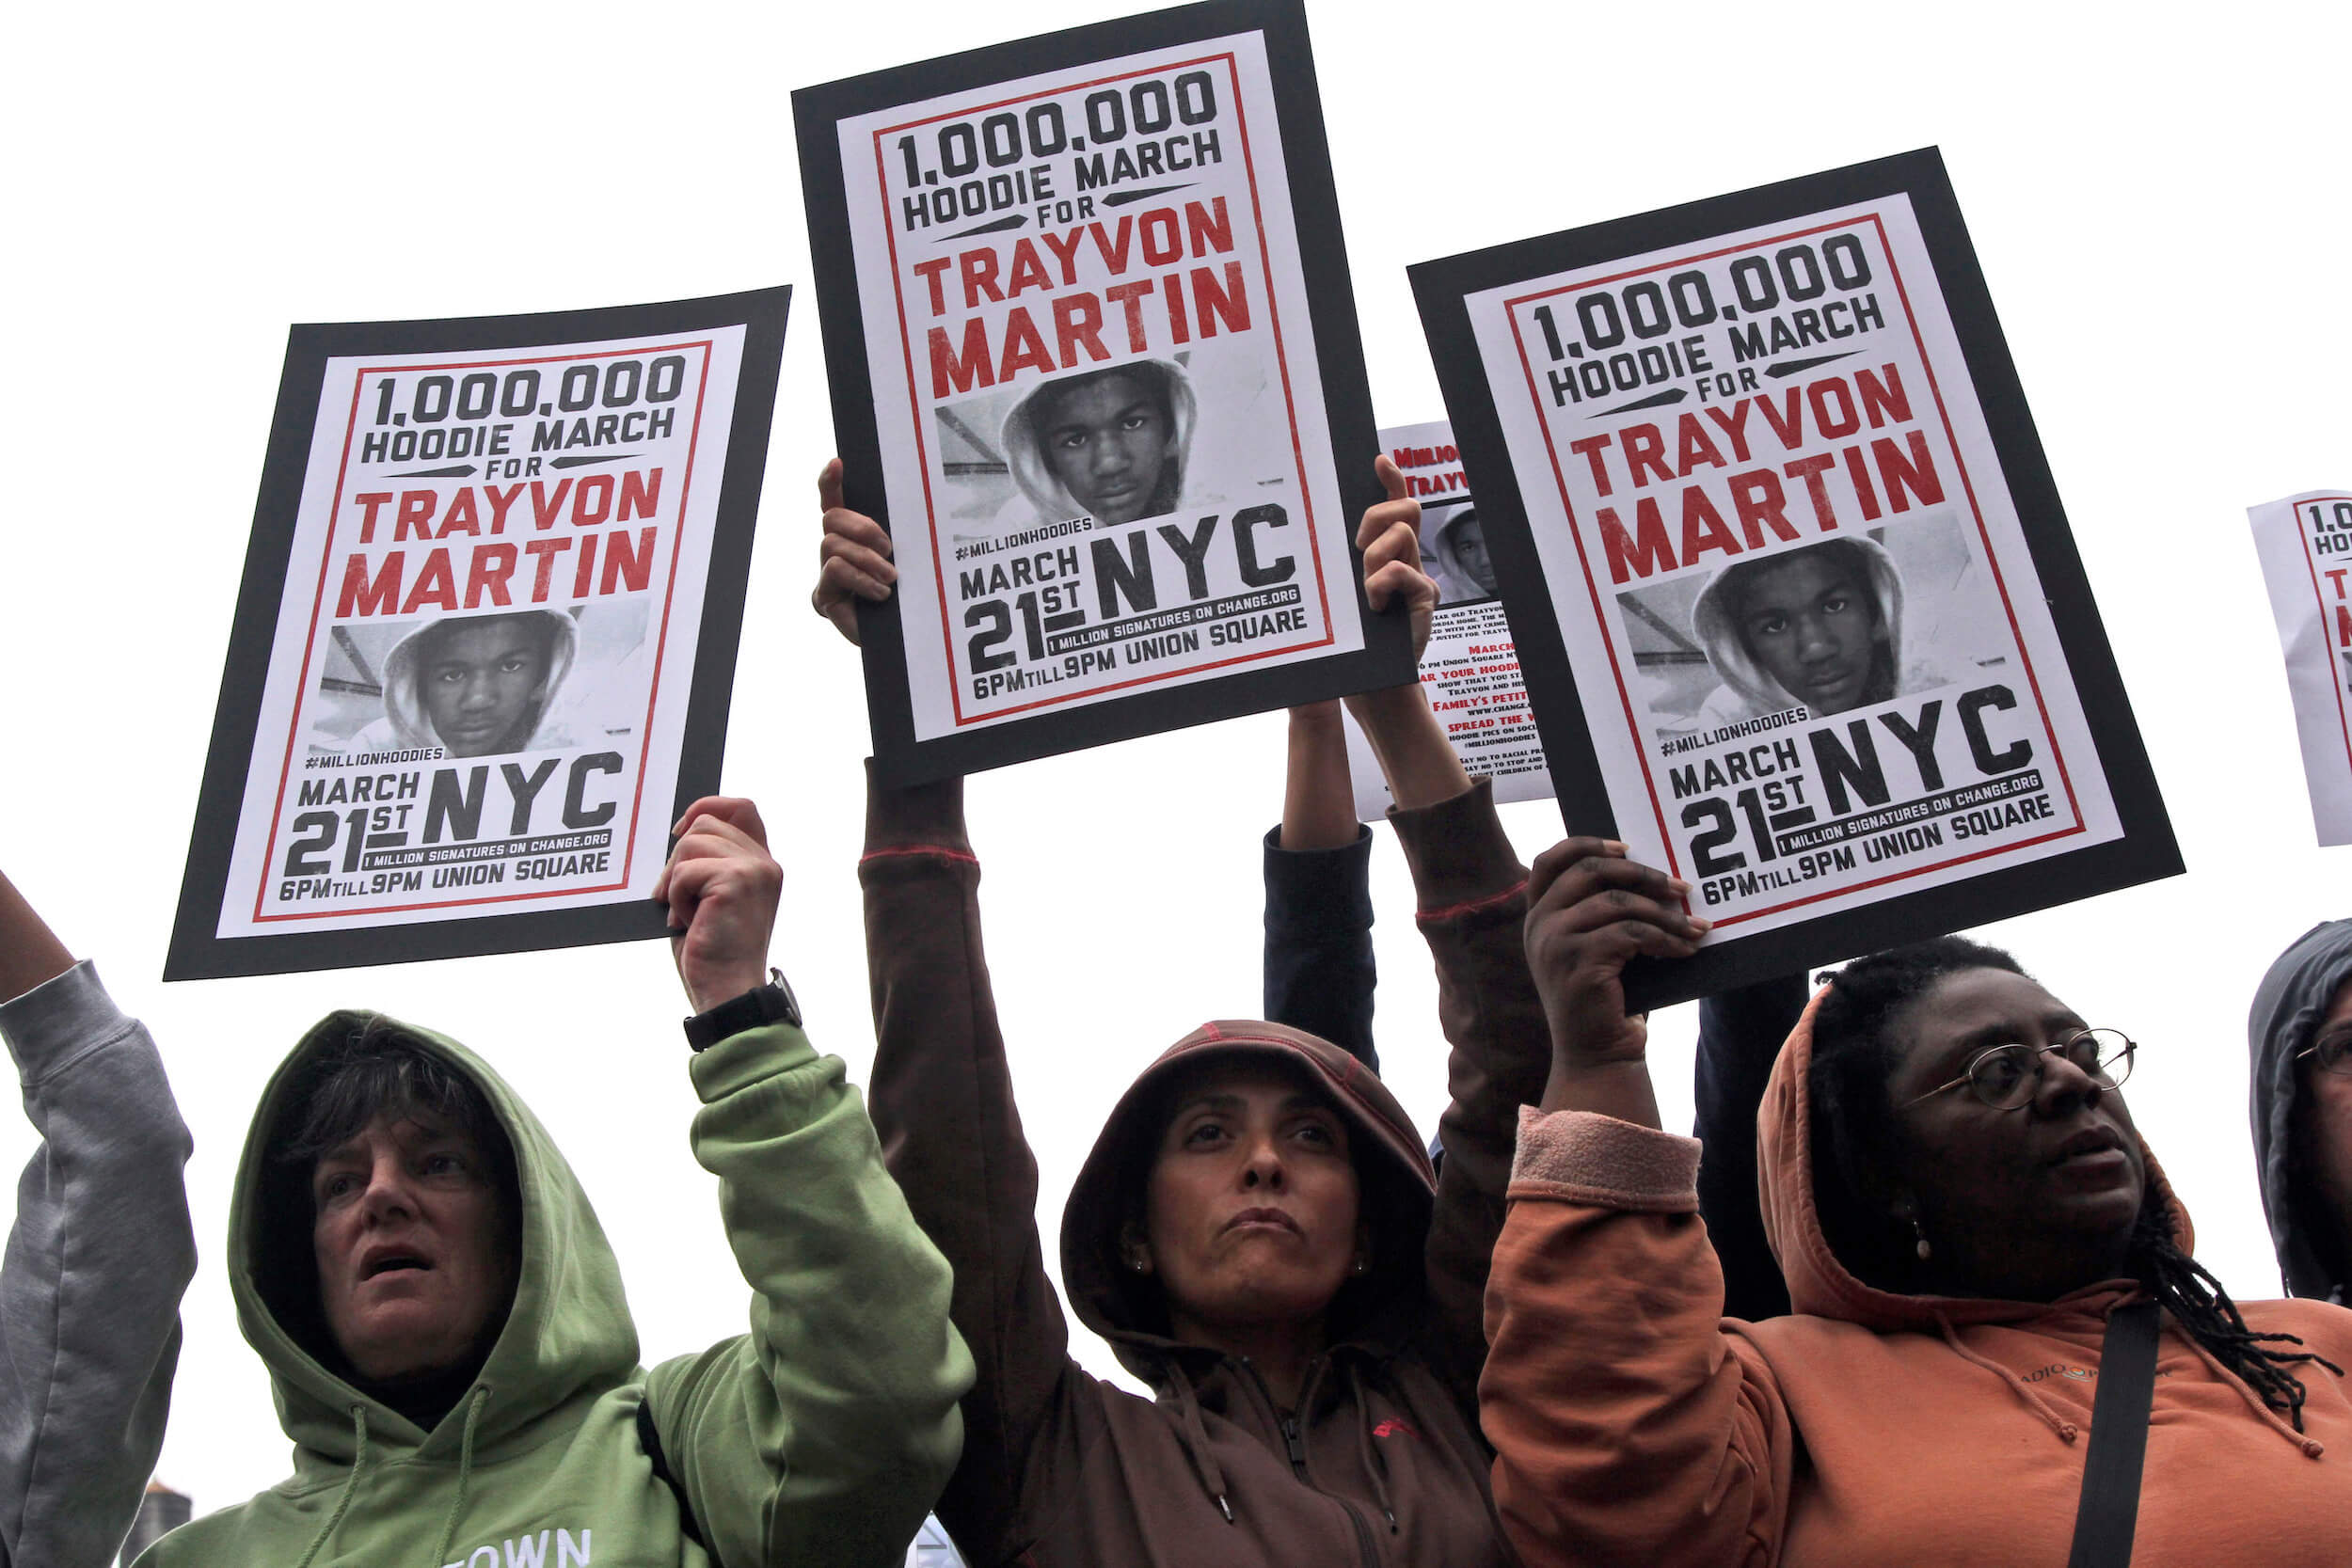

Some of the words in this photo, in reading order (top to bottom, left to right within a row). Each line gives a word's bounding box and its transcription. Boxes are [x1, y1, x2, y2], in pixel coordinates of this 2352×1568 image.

[902, 164, 1055, 231] HOODIE
[1074, 129, 1222, 191] MARCH
[1037, 196, 1096, 228] FOR
[914, 196, 1234, 317] TRAYVON
[928, 261, 1251, 399] MARTIN
[1548, 334, 1712, 407] HOODIE
[1727, 293, 1885, 363] MARCH
[1696, 367, 1760, 402] FOR
[361, 424, 514, 463] HOODIE
[532, 407, 675, 451] MARCH
[1570, 362, 1914, 497] TRAYVON
[485, 456, 542, 480] FOR
[355, 467, 663, 544] TRAYVON
[1596, 429, 1946, 584] MARTIN
[955, 517, 1092, 561] #MILLIONHOODIES
[1090, 503, 1296, 620] NYC
[335, 526, 658, 618] MARTIN
[960, 546, 1080, 600] MARCH
[1049, 641, 1055, 651] 1
[1059, 629, 1108, 650] MILLION
[1114, 610, 1190, 637] SIGNATURES
[1196, 606, 1213, 619] ON
[1218, 590, 1297, 615] CHANGE.ORG
[1127, 629, 1199, 665] UNION
[1210, 607, 1308, 647] SQUARE
[1442, 657, 1470, 666] UNION
[1471, 654, 1503, 662] SQUARE
[1469, 642, 1515, 655] MARCH
[1437, 680, 1461, 689] SHOW
[1465, 676, 1486, 685] THAT
[1440, 668, 1475, 680] YOUR
[1447, 686, 1490, 696] TRAYVON
[1432, 695, 1488, 712] FAMILY'S
[1447, 719, 1495, 733] SPREAD
[1499, 715, 1523, 725] THE
[1449, 732, 1479, 742] HOODIE
[1483, 729, 1500, 737] PICS
[1517, 724, 1537, 733] SOCI
[1502, 750, 1528, 758] RACIAL
[1661, 707, 1808, 757] #MILLIONHOODIES
[1808, 684, 2033, 816] NYC
[305, 748, 443, 769] #MILLIONHOODIES
[1497, 767, 1532, 776] CHILDREN
[1669, 737, 1801, 800] MARCH
[298, 772, 421, 806] MARCH
[422, 751, 624, 844] NYC
[1779, 840, 1787, 853] 1
[1790, 827, 1844, 851] MILLION
[1849, 804, 1929, 835] SIGNATURES
[1933, 798, 1950, 812] ON
[1955, 774, 2039, 806] CHANGE.ORG
[1867, 823, 1943, 863] UNION
[1951, 794, 2055, 841] SQUARE
[364, 858, 371, 868] 1
[374, 852, 423, 866] MILLION
[428, 845, 504, 863] SIGNATURES
[510, 843, 526, 853] ON
[531, 833, 608, 852] CHANGE.ORG
[432, 863, 505, 889] UNION
[515, 852, 610, 880] SQUARE
[441, 1528, 591, 1568] OWN
